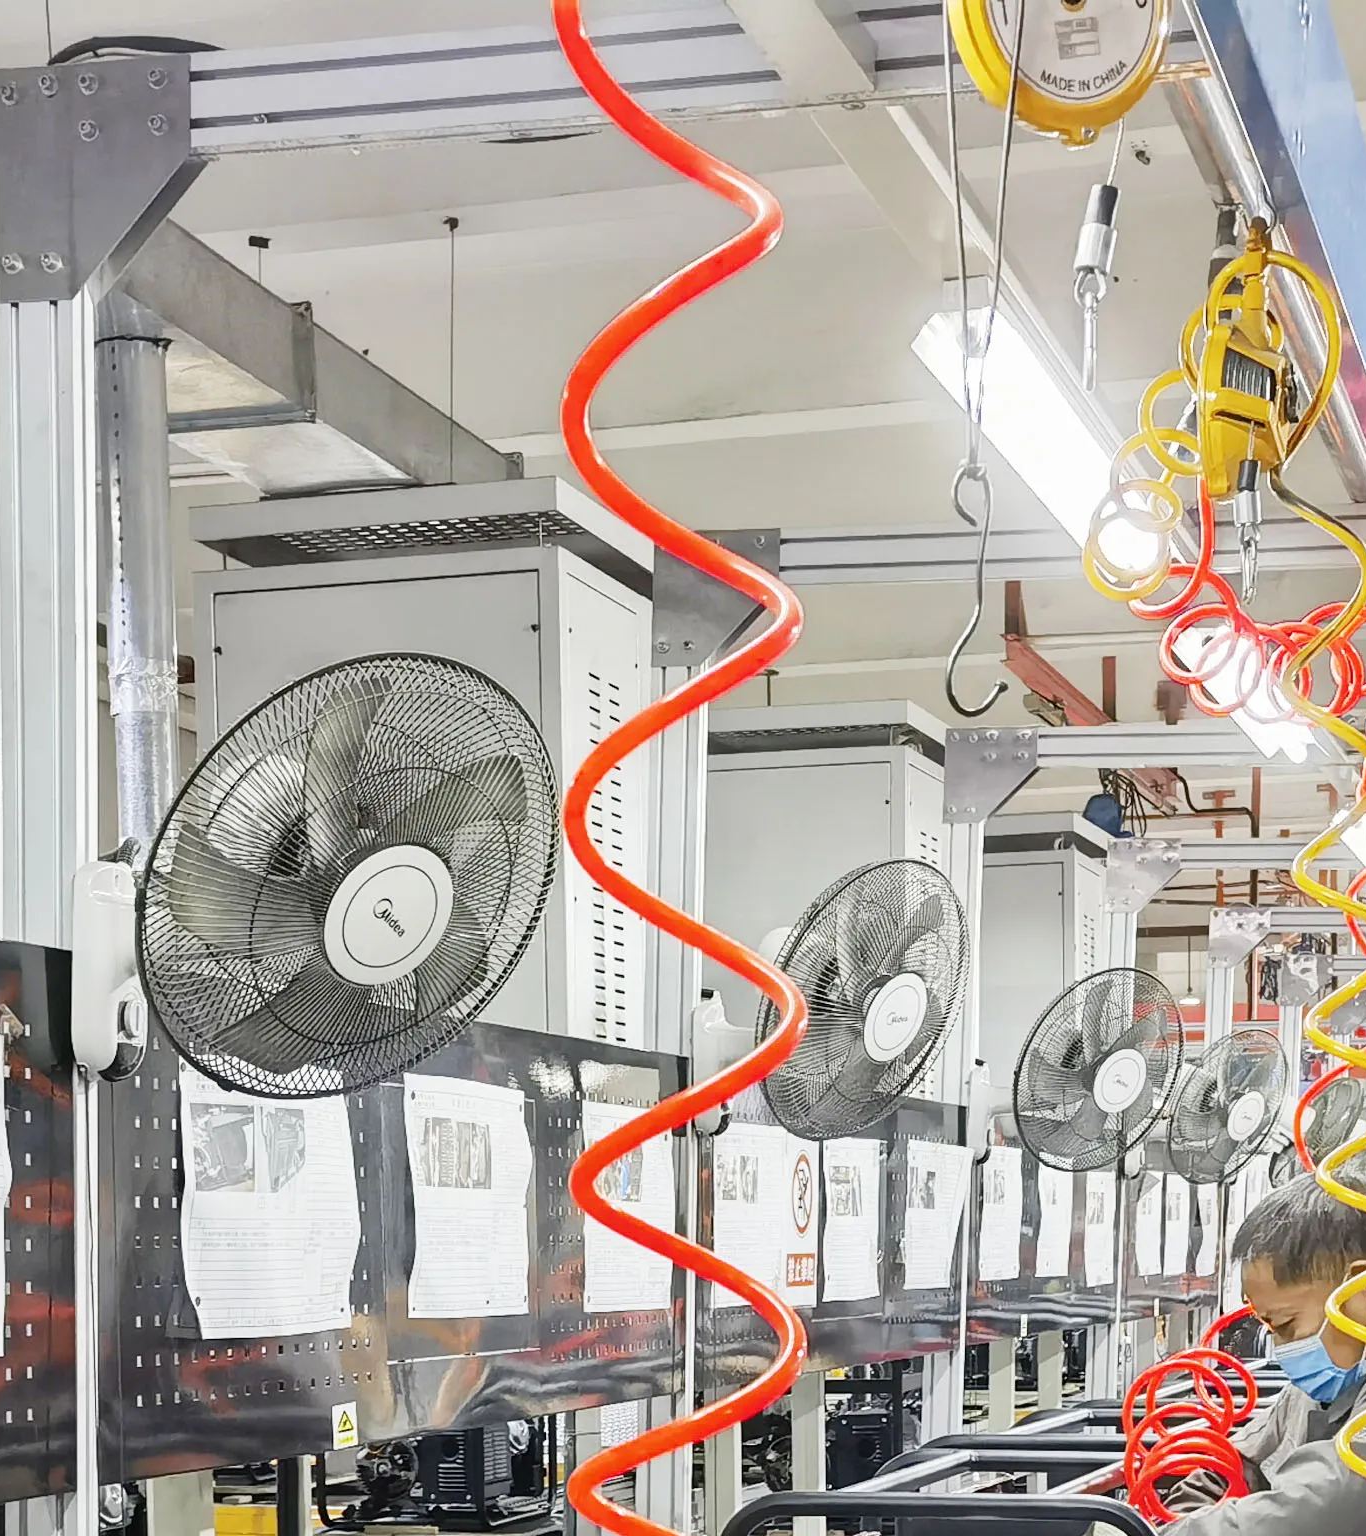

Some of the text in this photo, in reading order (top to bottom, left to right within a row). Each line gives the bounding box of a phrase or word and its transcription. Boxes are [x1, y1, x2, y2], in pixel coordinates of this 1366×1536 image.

[1040, 60, 1128, 92] MADE IN CHINA
[378, 908, 405, 938] Midea
